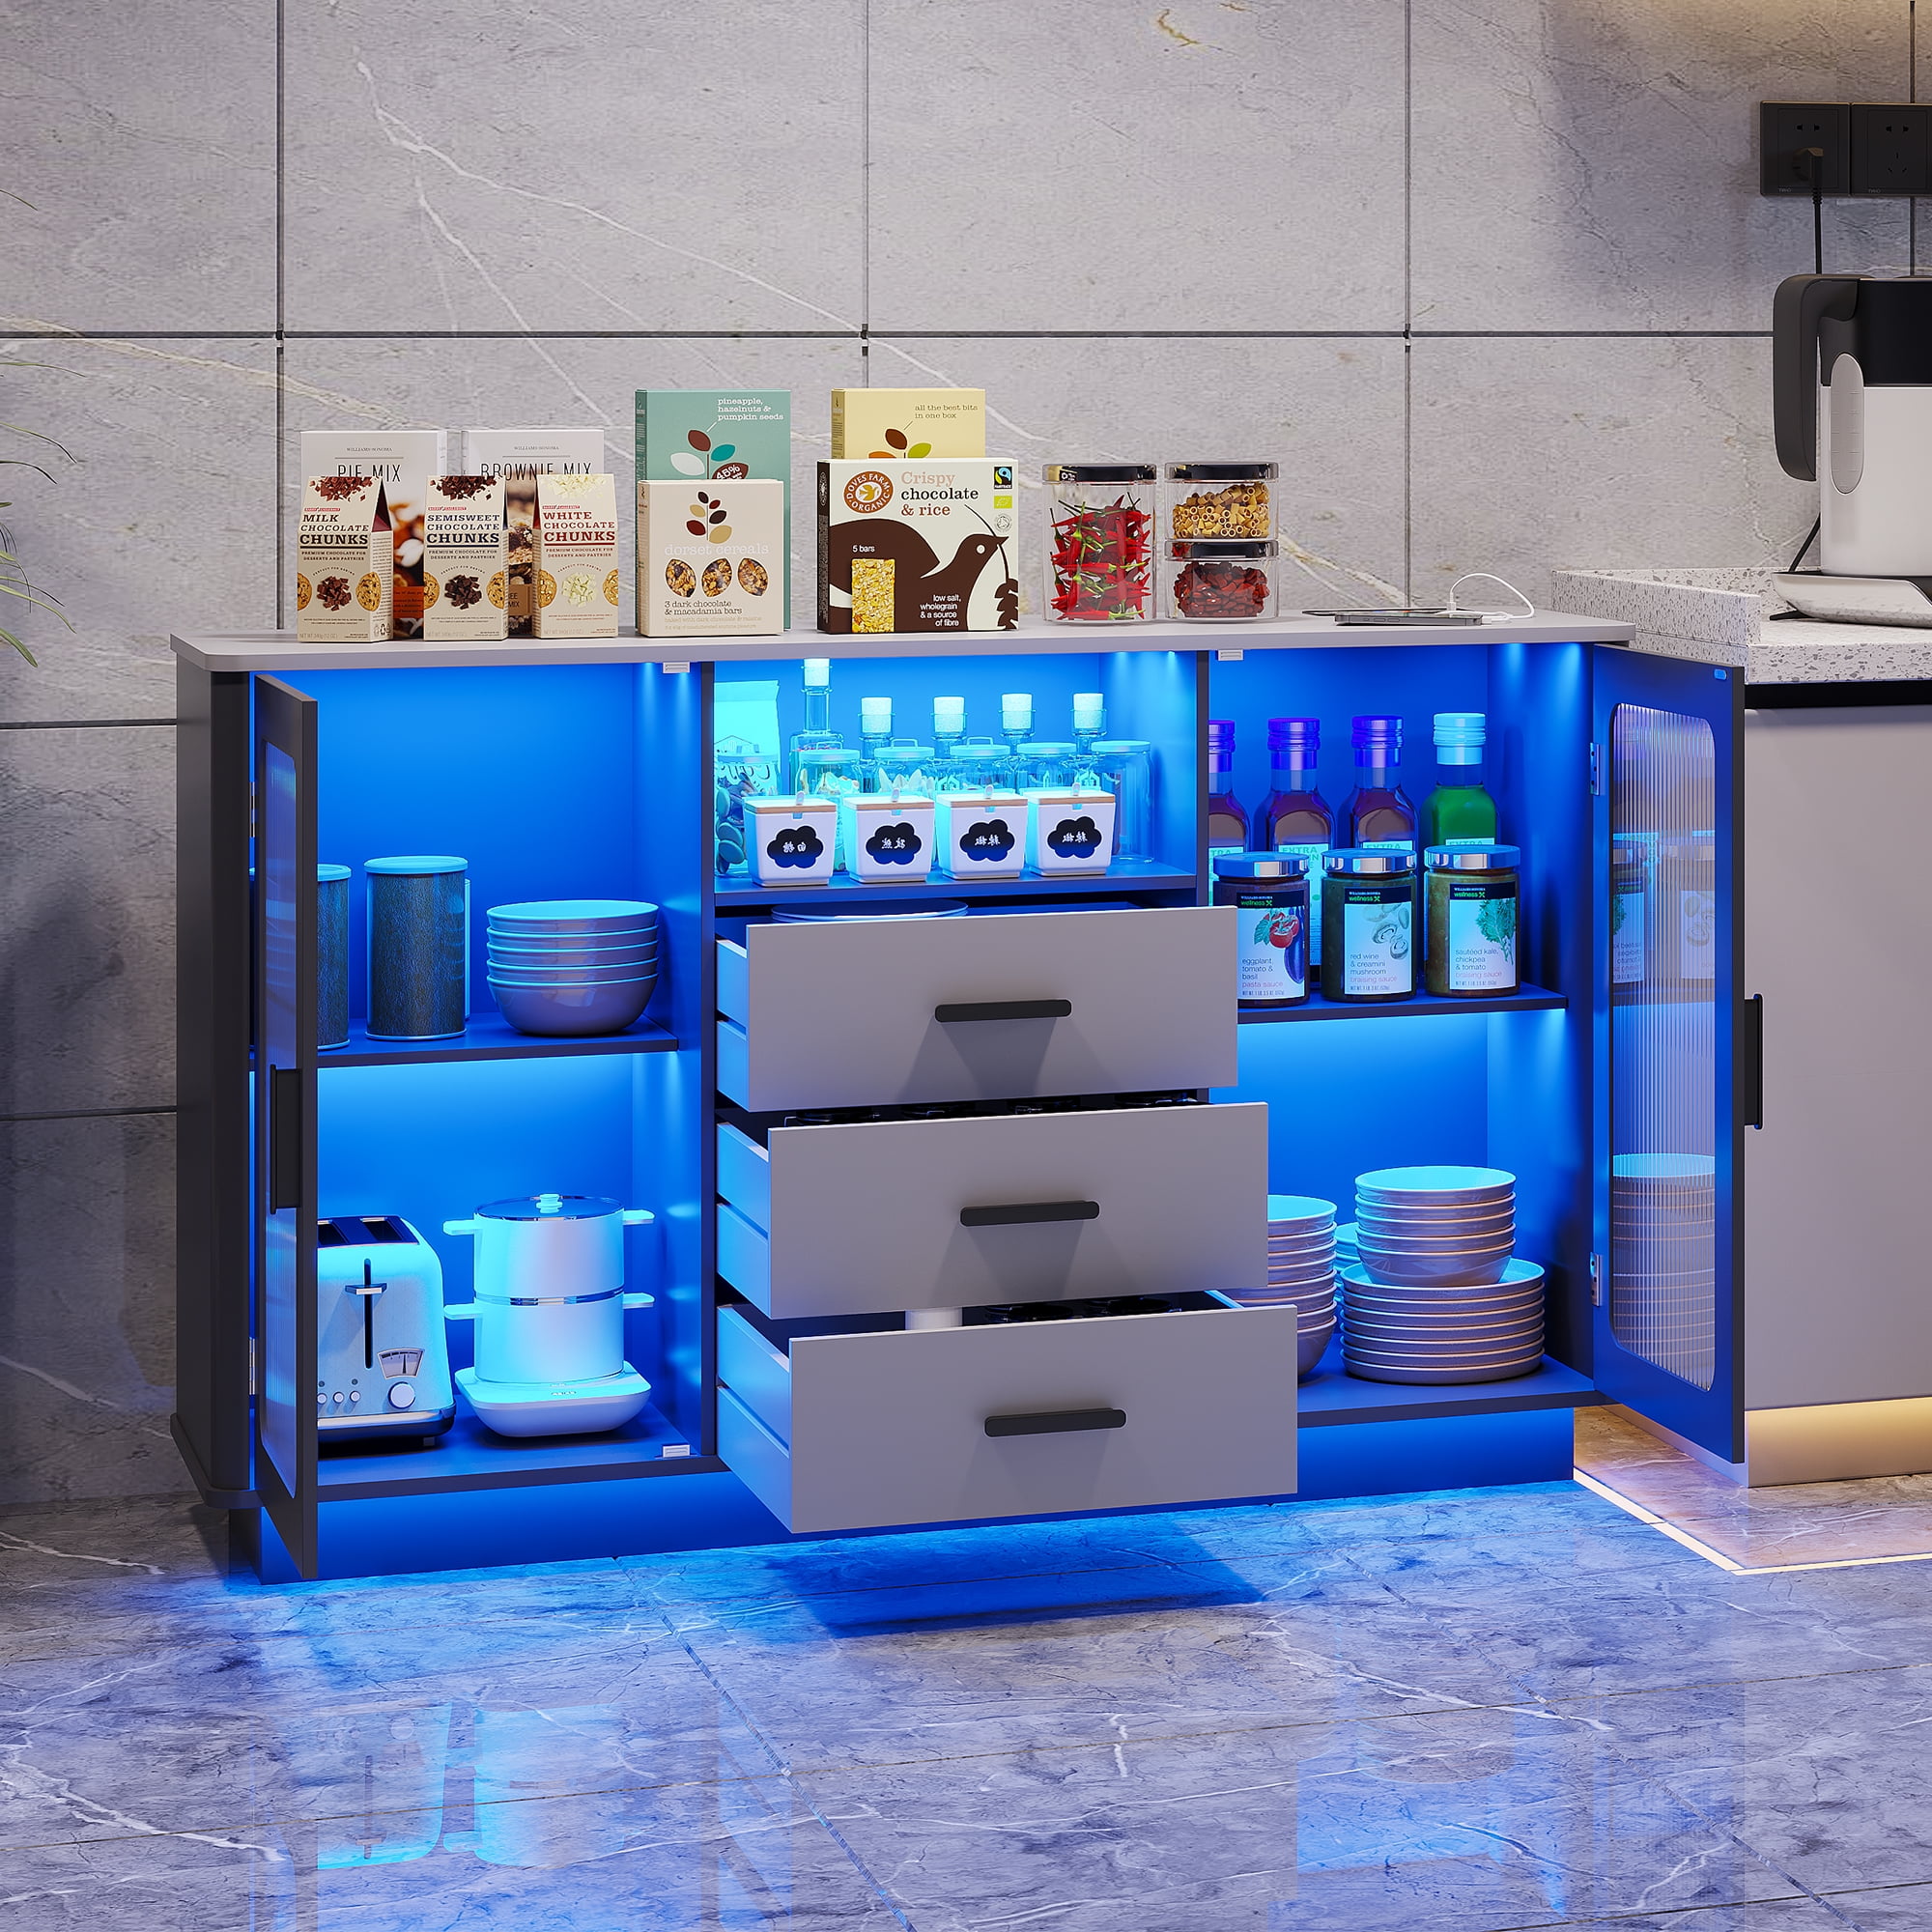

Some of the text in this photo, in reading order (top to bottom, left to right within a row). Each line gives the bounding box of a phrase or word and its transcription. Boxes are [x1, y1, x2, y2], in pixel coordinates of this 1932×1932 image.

[372, 465, 401, 482] MIX
[480, 463, 592, 481] BROWNIE MIX
[846, 472, 890, 499] DOVES FARM
[900, 471, 955, 488] Crispy
[900, 488, 979, 500] chocolate
[851, 493, 890, 512] ORGANIC
[543, 511, 592, 520] WHITE
[900, 503, 951, 516] & rice
[299, 534, 368, 545] CHUNKS
[427, 533, 499, 544] CHUNKS
[544, 531, 615, 542] CHUNKS
[664, 543, 769, 555] dorset cereals
[947, 594, 961, 603] salt,
[920, 603, 957, 611] wholegrain
